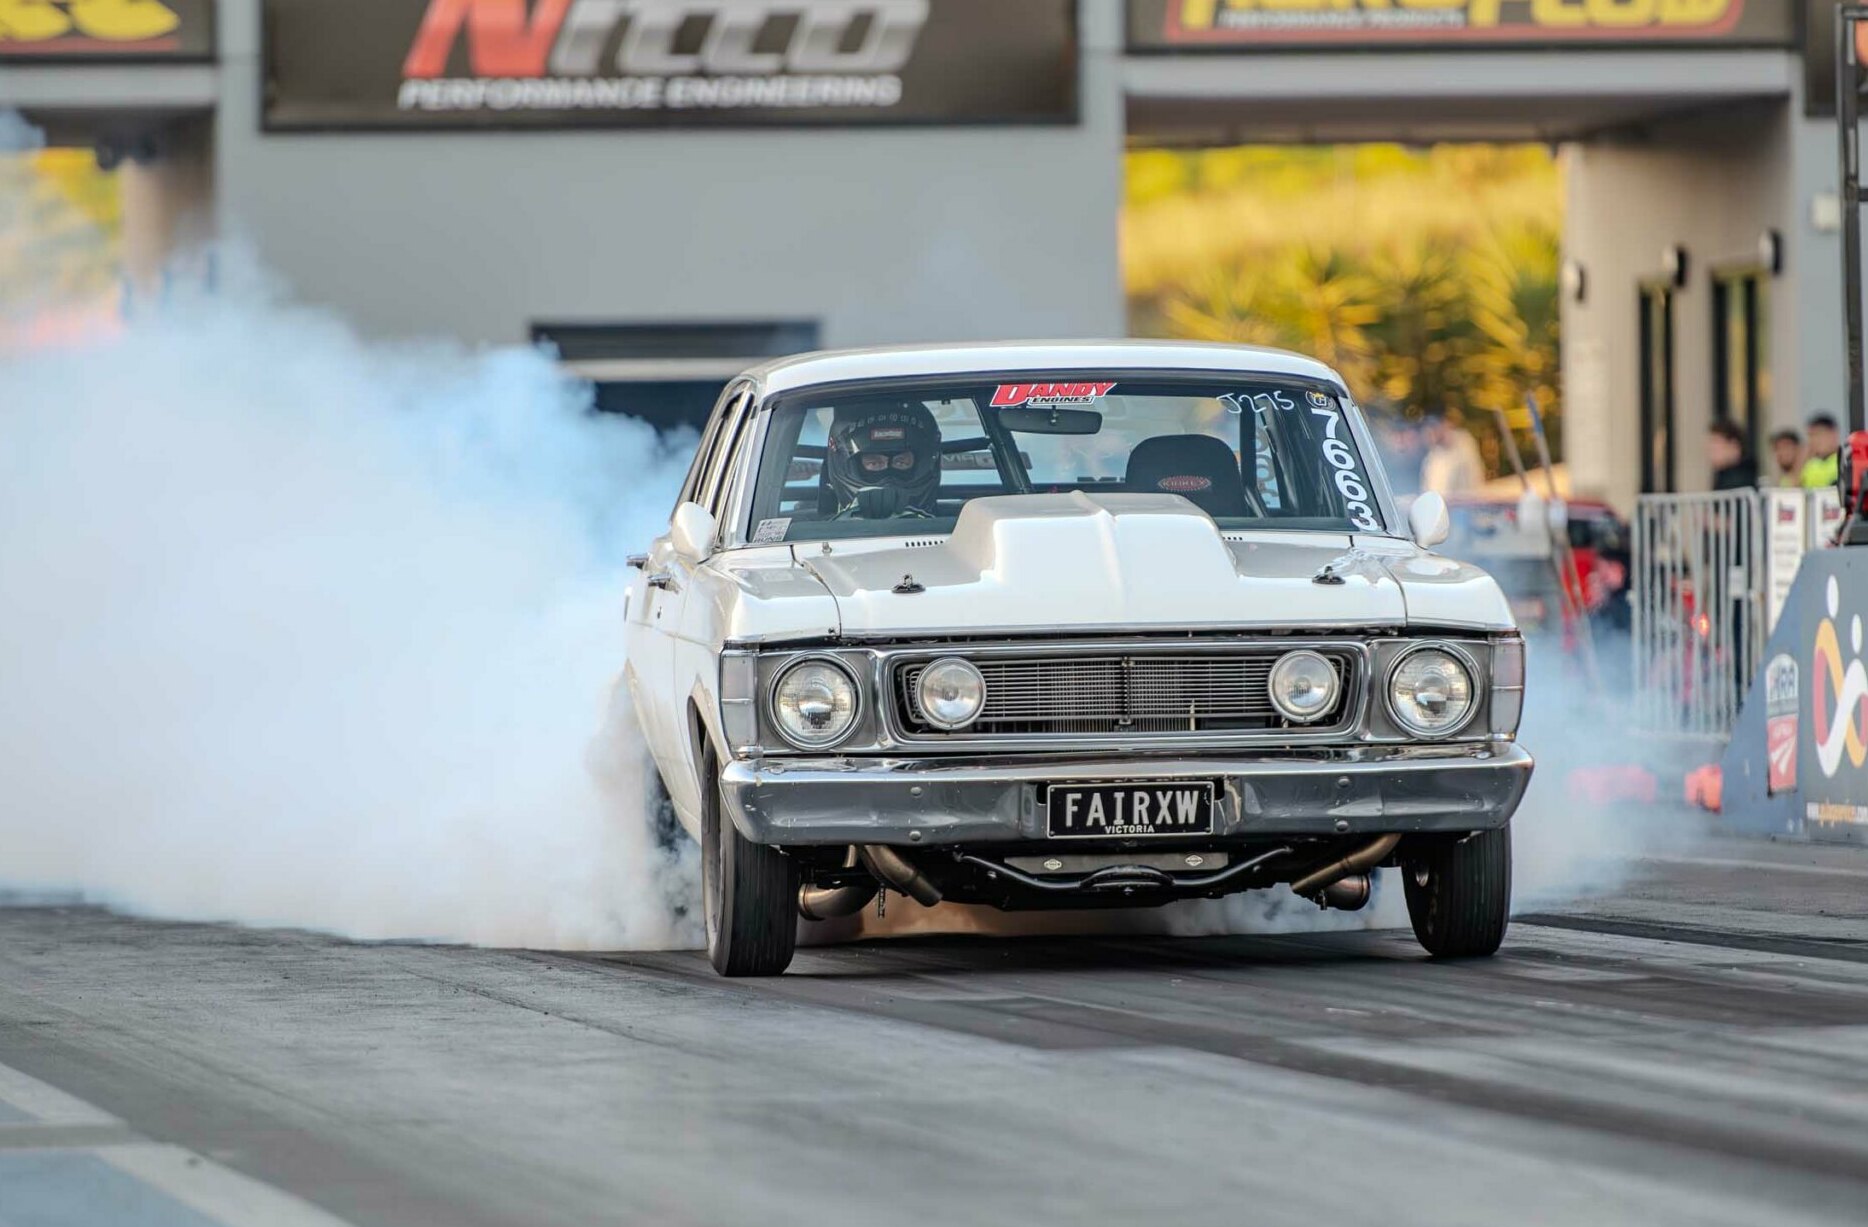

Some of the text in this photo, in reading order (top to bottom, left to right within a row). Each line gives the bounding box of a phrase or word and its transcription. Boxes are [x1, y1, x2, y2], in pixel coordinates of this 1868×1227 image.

[397, 75, 902, 110] PERFORMANCE ENGINEERING
[990, 383, 1117, 406] DANDY
[1216, 390, 1294, 414] J275
[1310, 408, 1378, 531] 7663
[1065, 790, 1200, 827] FAIRXW
[1104, 824, 1155, 834] VICTORIA
